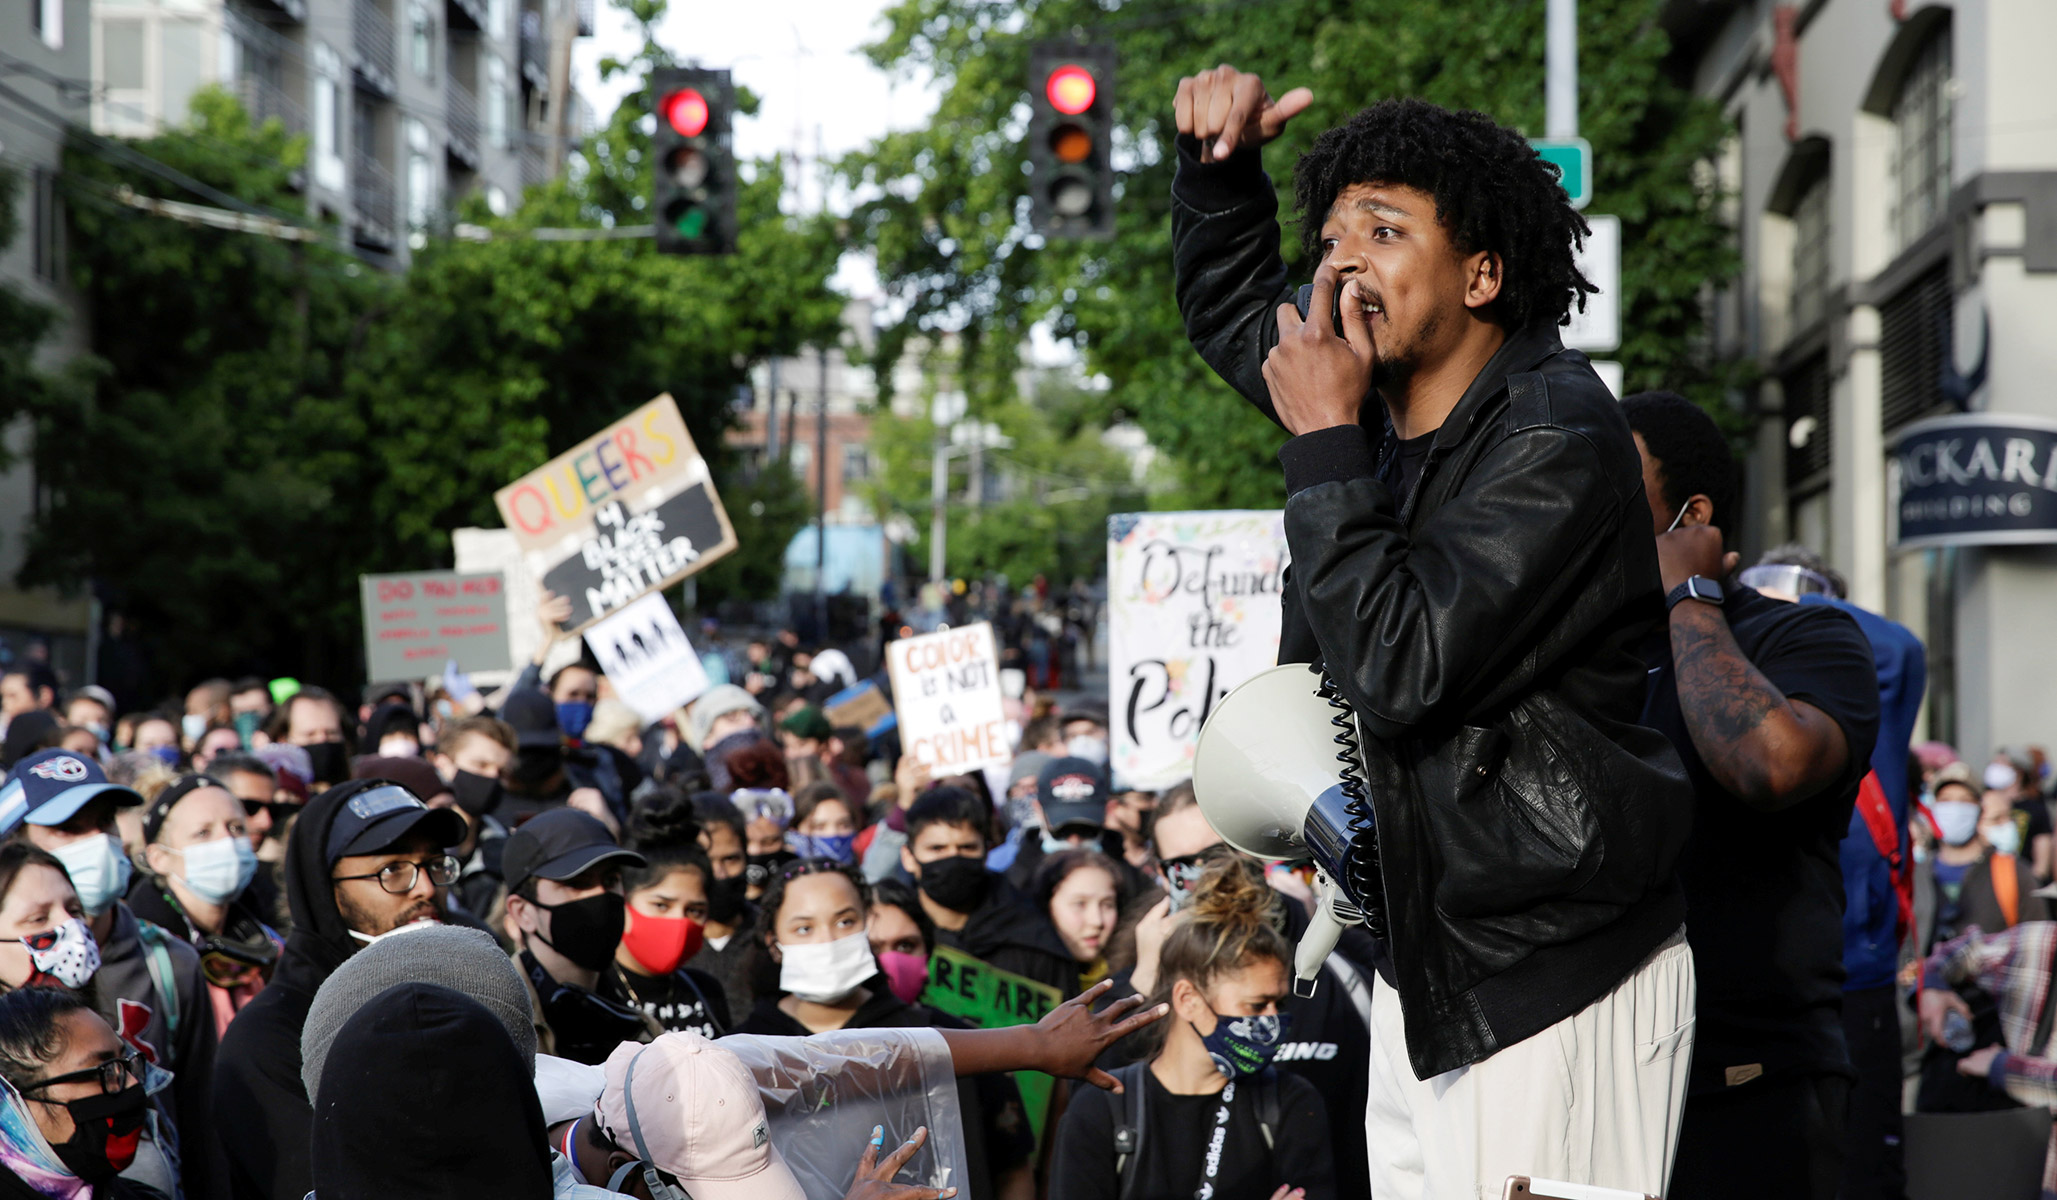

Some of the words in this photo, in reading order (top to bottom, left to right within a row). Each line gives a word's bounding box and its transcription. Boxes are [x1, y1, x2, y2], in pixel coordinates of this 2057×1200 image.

[508, 410, 676, 534] QUEERS
[582, 510, 665, 571] BLACK
[586, 536, 700, 619] MATTER
[1141, 540, 1286, 609] Defund
[906, 632, 981, 673] COLOR
[1188, 610, 1241, 647] the
[947, 660, 990, 692] NOT
[1127, 657, 1228, 746] Pol
[914, 720, 1004, 767] CRIME
[995, 980, 1053, 1018] ARE
[1206, 1126, 1226, 1178] adidas
